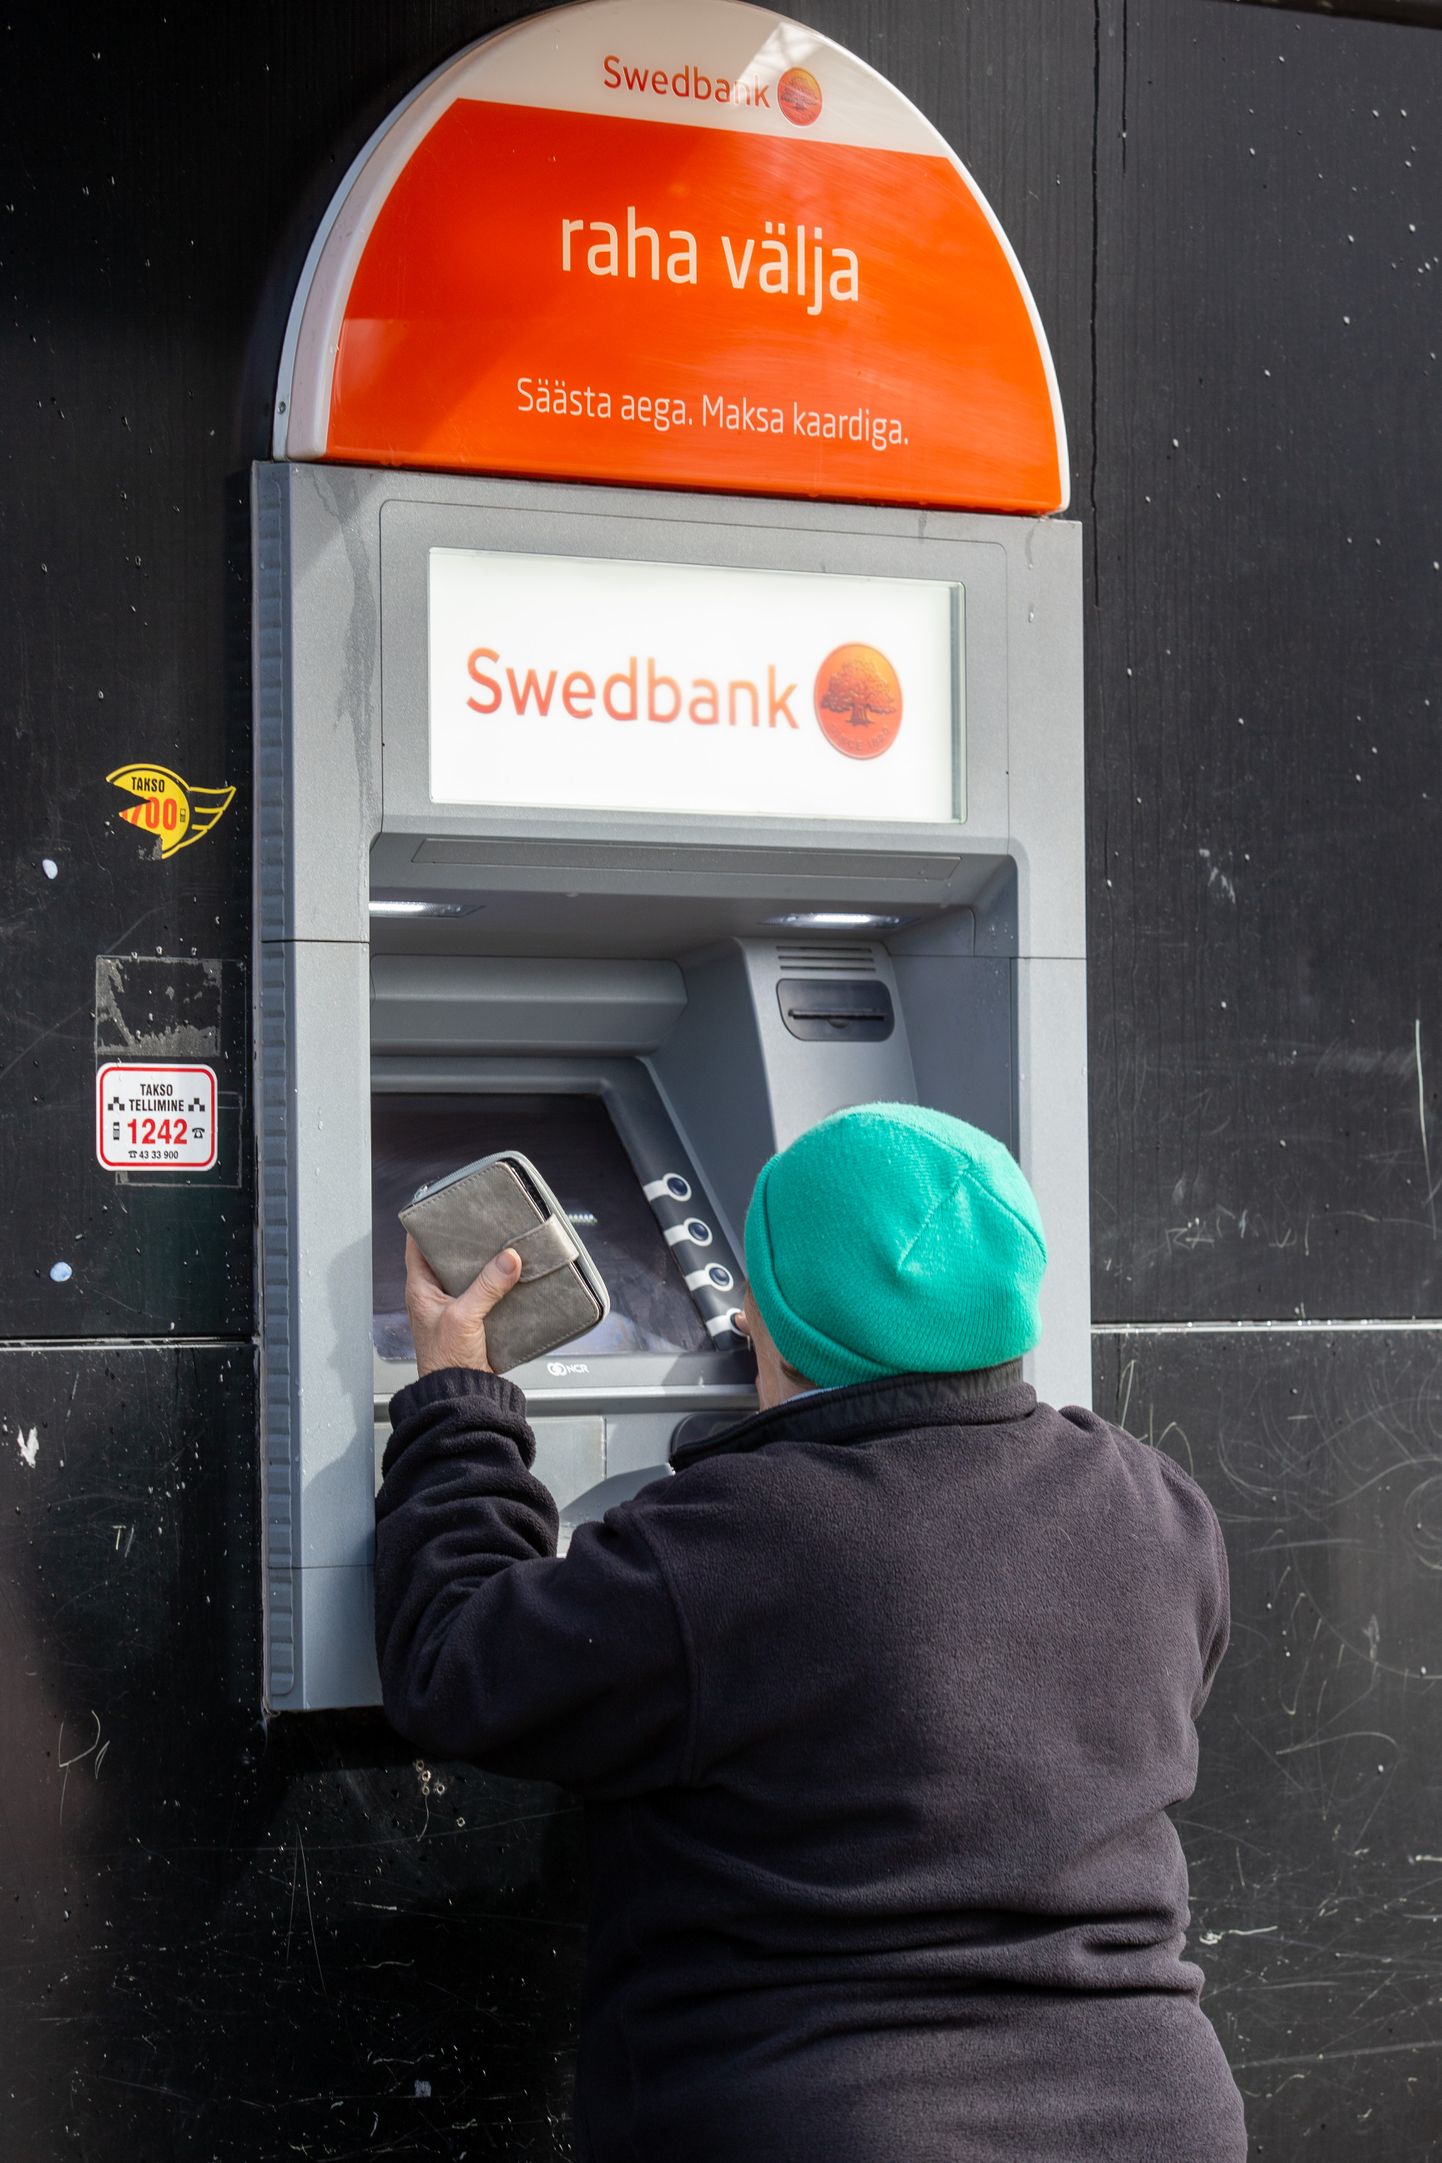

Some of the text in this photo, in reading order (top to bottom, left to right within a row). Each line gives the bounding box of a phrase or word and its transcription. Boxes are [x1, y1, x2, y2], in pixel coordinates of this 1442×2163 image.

[603, 55, 770, 109] Swedbank
[562, 206, 859, 316] raha välja
[516, 377, 909, 452] Säästa aega. Maksa kaardiga.
[465, 646, 800, 730] Swedbank
[131, 776, 165, 793] TAKSO
[140, 1083, 174, 1097] TAKSO
[129, 1099, 185, 1112] TELLIMINE
[127, 1118, 188, 1145] 1242
[139, 1150, 179, 1160] 43 33 900
[566, 1363, 590, 1374] NCR
